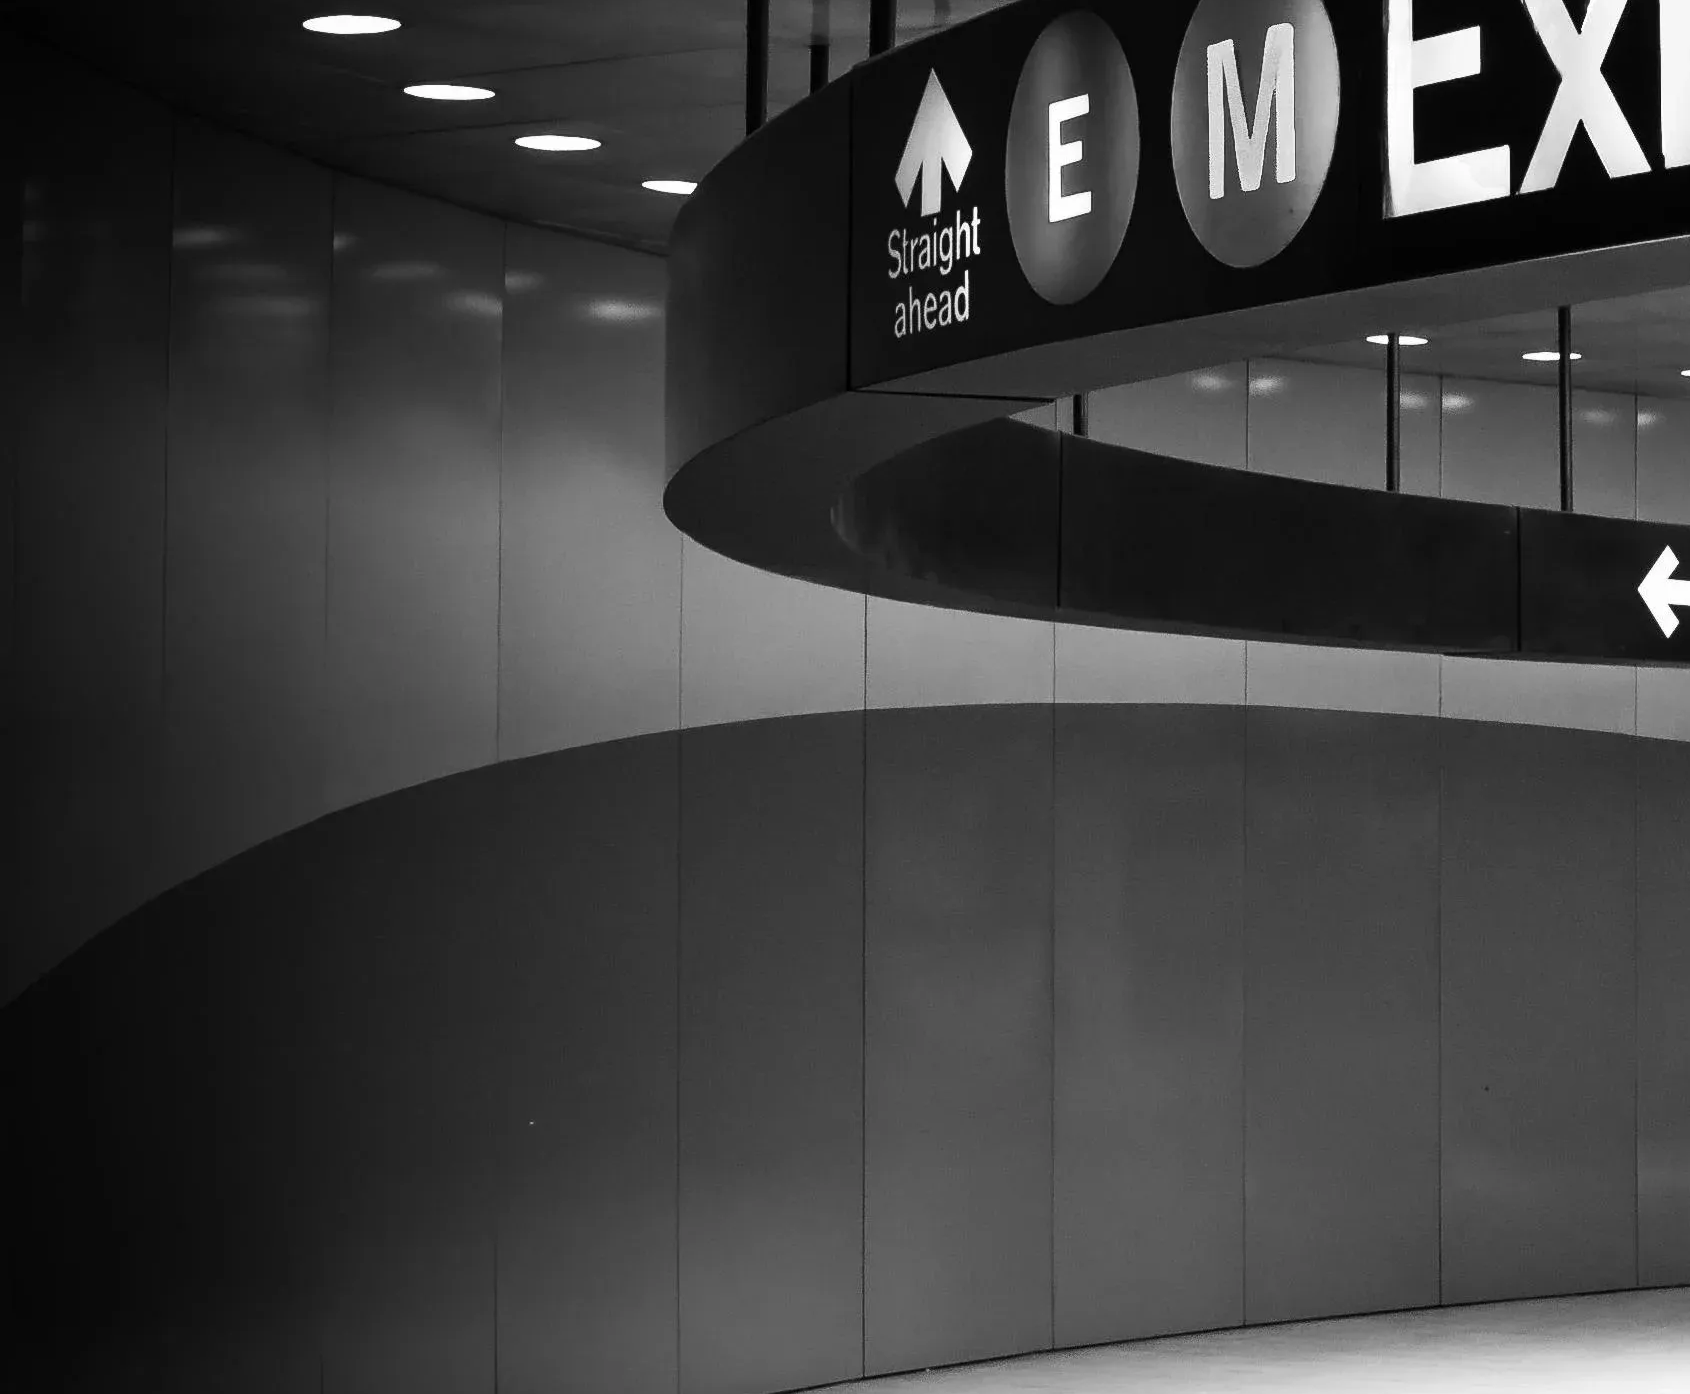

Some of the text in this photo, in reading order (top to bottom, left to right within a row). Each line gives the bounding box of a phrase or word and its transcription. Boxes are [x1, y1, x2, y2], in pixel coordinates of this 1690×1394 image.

[1047, 20, 1311, 223] E M
[887, 205, 982, 280] Straight
[893, 268, 970, 339] ahead
